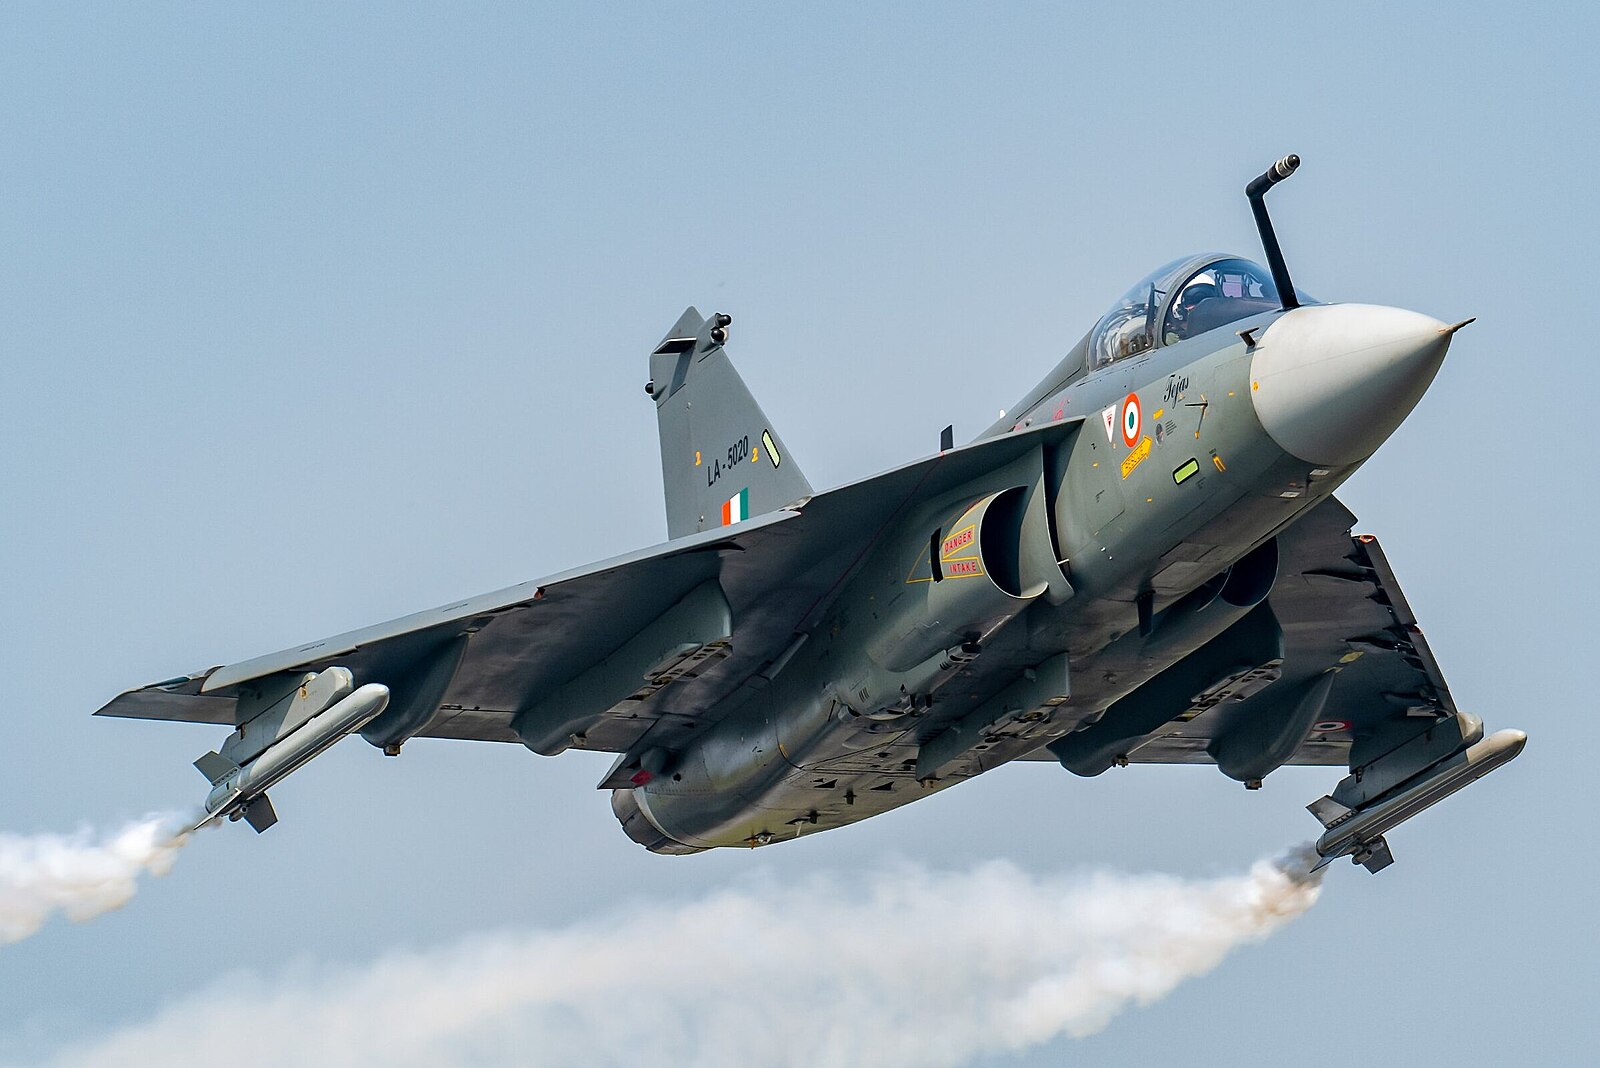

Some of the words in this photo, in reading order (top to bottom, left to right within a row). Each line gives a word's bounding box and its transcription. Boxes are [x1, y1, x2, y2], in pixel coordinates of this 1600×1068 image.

[1163, 374, 1189, 409] Tejas
[751, 447, 759, 462] 2
[944, 531, 972, 552] DANGER
[949, 562, 976, 574] INTAKE
